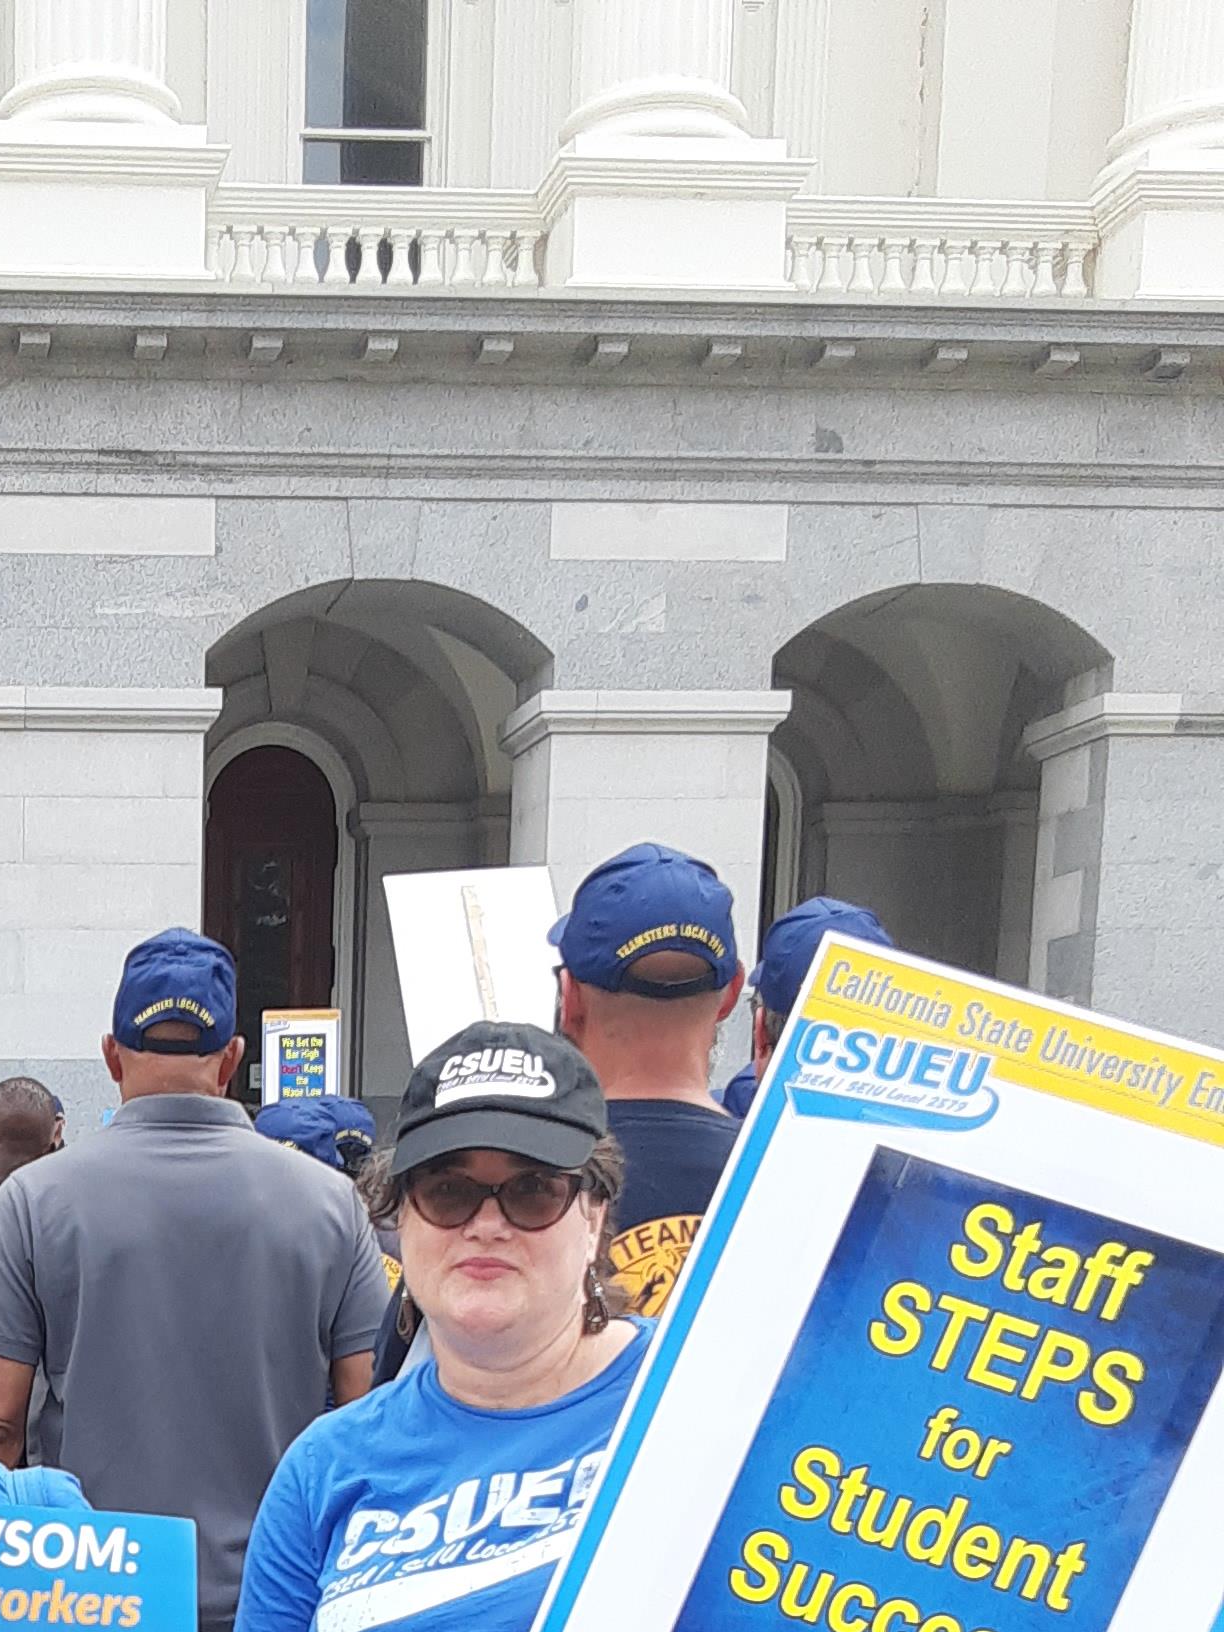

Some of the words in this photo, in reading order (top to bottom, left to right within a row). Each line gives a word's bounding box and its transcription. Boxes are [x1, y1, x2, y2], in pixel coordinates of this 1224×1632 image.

[616, 923, 677, 958] TEAMSTERS
[680, 923, 708, 942] LOCAL
[134, 997, 174, 1026] TEAMSTERS
[825, 960, 952, 1029] California
[958, 1000, 1033, 1054] State
[1039, 1025, 1184, 1107] University
[439, 1048, 544, 1081] CSUEU
[799, 1022, 992, 1097] CSUEU
[887, 1086, 927, 1105] Local
[950, 1203, 1154, 1322] Staff
[868, 1283, 1145, 1427] STEPS
[918, 1407, 1012, 1480] for
[779, 1445, 1087, 1612] Student
